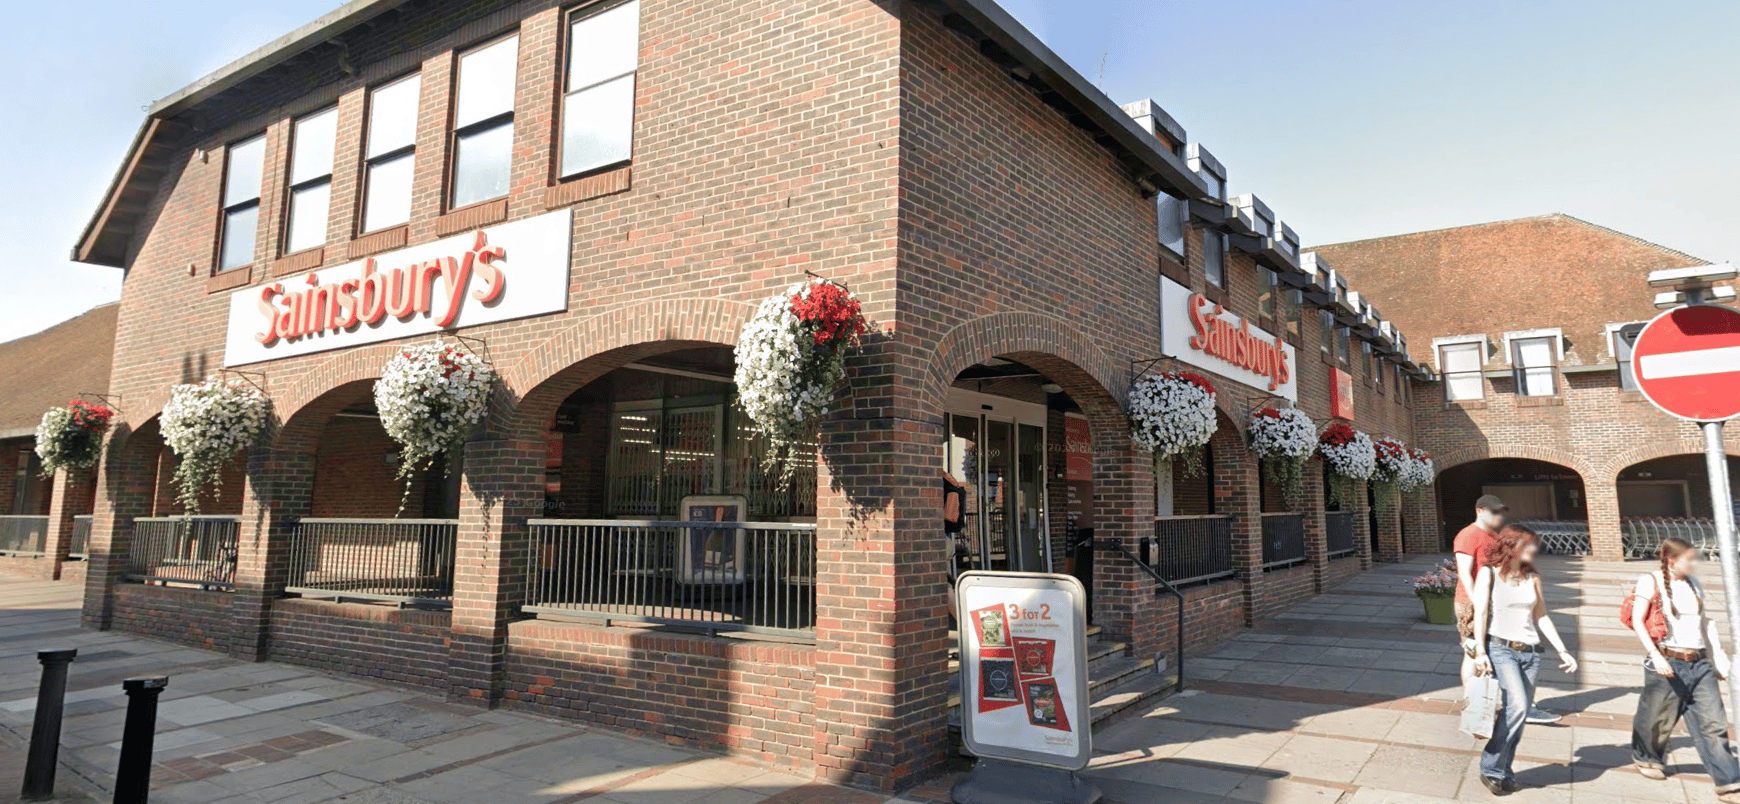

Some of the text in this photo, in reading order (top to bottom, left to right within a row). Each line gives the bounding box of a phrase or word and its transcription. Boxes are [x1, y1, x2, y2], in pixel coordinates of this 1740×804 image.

[254, 230, 506, 346] Sainsbury's
[1189, 293, 1289, 391] Sainsbury's
[1009, 603, 1051, 620] 3 for 2
